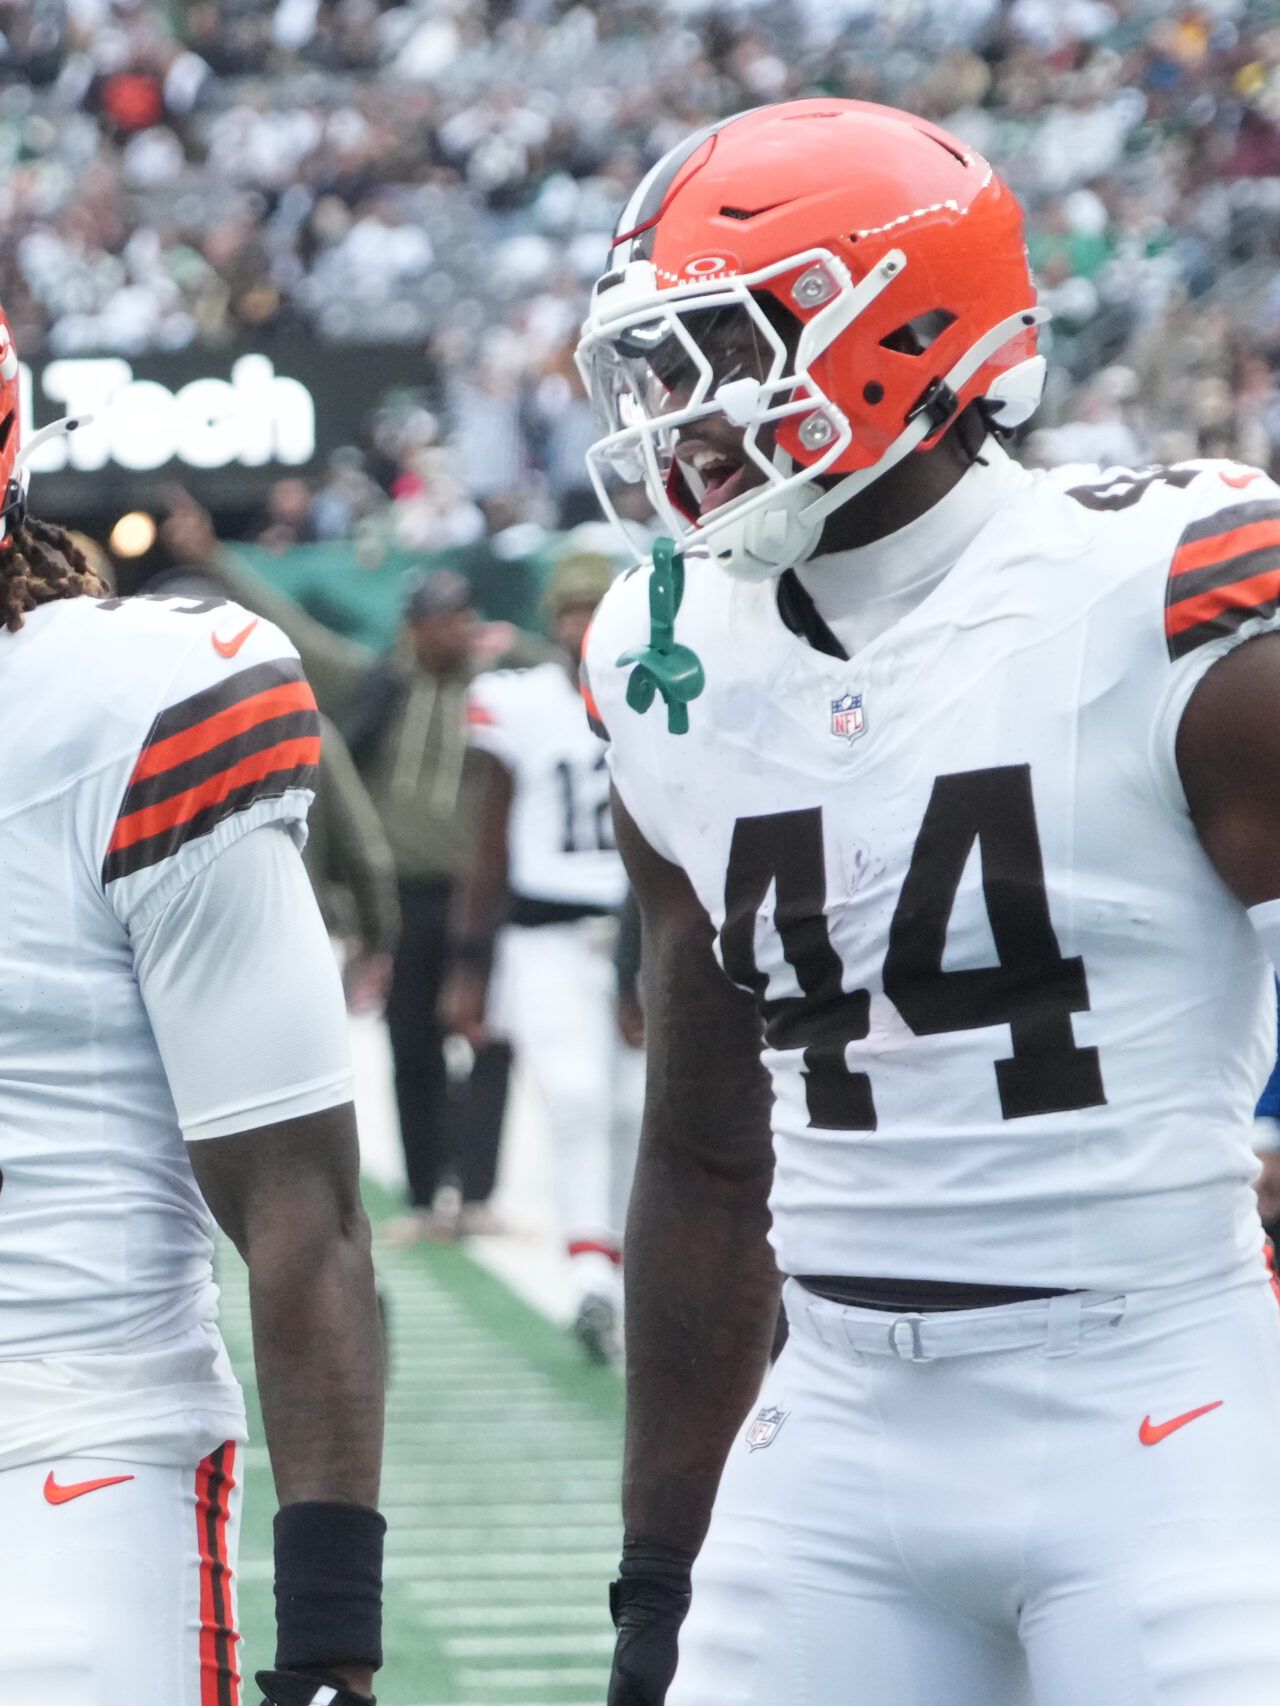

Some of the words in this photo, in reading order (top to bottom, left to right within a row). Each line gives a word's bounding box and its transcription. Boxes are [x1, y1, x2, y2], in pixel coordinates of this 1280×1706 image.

[834, 710, 862, 734] NFL
[720, 763, 1108, 1131] 44
[751, 1421, 773, 1442] NFL
